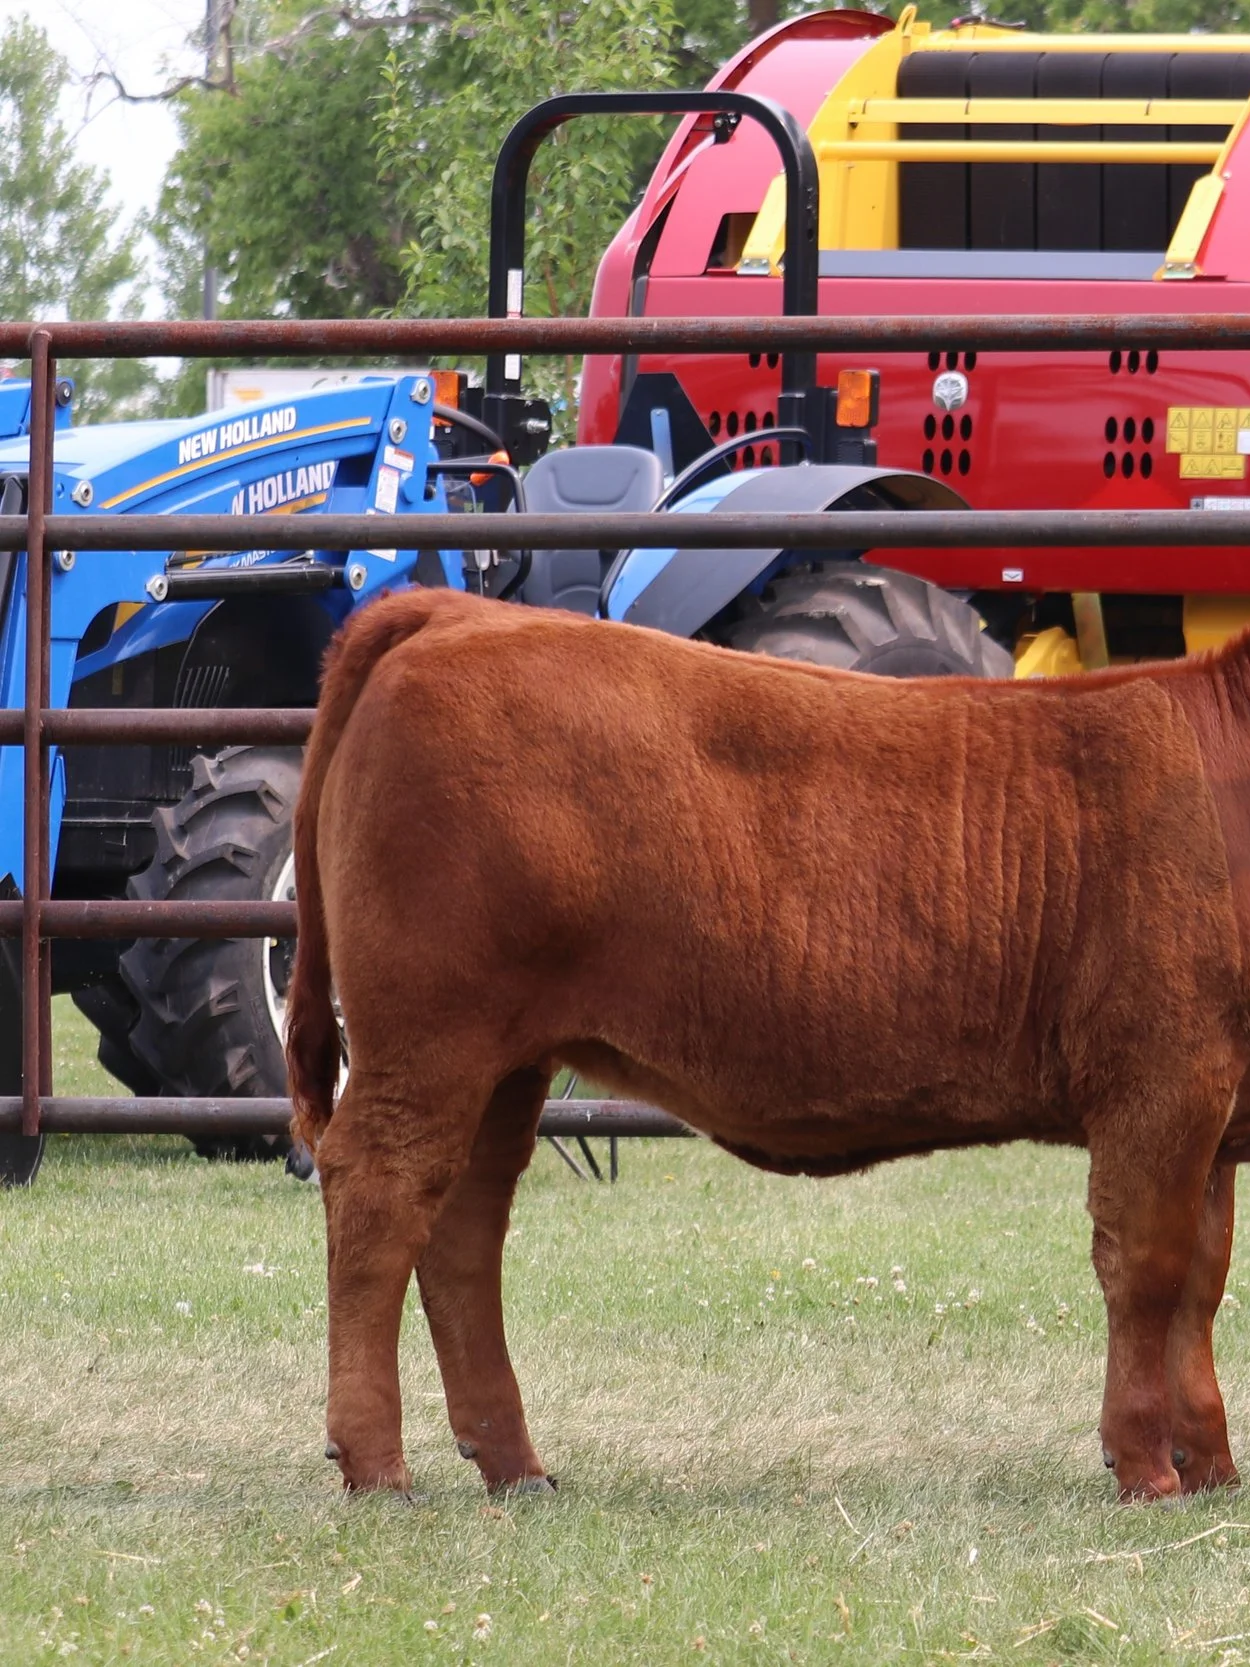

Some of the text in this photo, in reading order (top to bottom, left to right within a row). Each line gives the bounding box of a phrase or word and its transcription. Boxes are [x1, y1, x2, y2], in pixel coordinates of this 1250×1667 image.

[179, 407, 296, 465] NEW HOLLAND
[249, 461, 335, 515] HOLLAND
